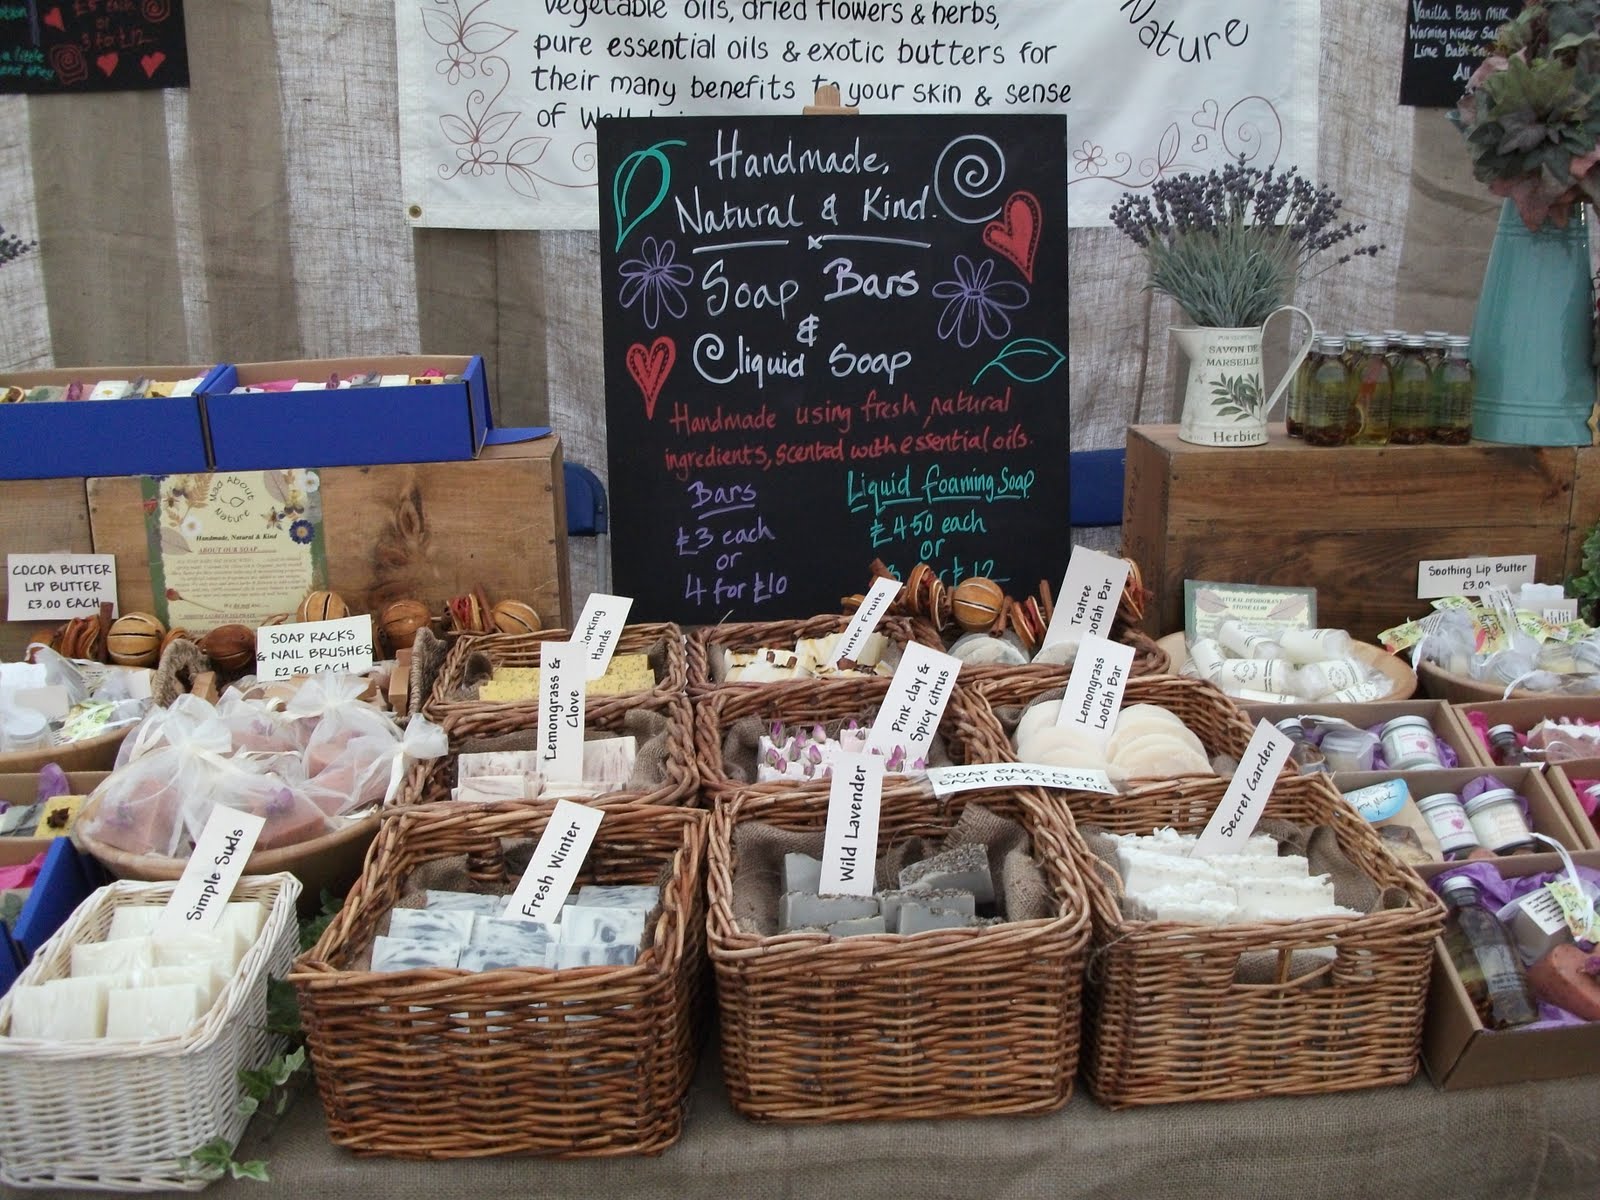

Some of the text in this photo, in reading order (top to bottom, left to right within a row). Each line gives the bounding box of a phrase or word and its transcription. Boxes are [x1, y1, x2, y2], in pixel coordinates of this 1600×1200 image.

[545, 0, 1000, 30] vegetable oils, dried flowers & herbs,
[1412, 0, 1512, 22] Vanilla Bath Milk
[533, 32, 1058, 65] pure essential oils & exotic butters for
[531, 65, 600, 91] their
[611, 76, 676, 106] many
[691, 74, 795, 100] benefits
[845, 83, 904, 107] your
[913, 84, 962, 104] skin
[975, 85, 992, 106] &
[1005, 82, 1072, 104] sense
[537, 102, 567, 128] of
[709, 128, 889, 180] Handmade,
[675, 184, 938, 235] Natural & Kind.
[702, 257, 919, 320] Soap Bars
[797, 313, 820, 347] &
[1208, 344, 1259, 354] SAVON DE
[829, 342, 912, 385] Soap
[1206, 357, 1260, 367] MARSEILLE
[669, 401, 777, 436] Handmade
[796, 400, 851, 433] using
[930, 386, 1012, 416] natural
[664, 423, 1034, 481] ingredients, scented with essential oils.
[209, 475, 255, 523] Mad About Nature
[688, 480, 757, 509] Bars
[847, 464, 911, 516] Liquid
[997, 466, 1035, 499] Soap
[676, 516, 776, 556] £3 each
[942, 508, 987, 535] each
[716, 552, 742, 571] or
[920, 538, 945, 560] or
[12, 564, 112, 576] COCOA BUTTER
[25, 581, 102, 592] LIP BUTTER
[685, 572, 787, 605] 4 for £10
[1428, 562, 1527, 578] Soothing Lip Butter
[28, 597, 100, 610] £3.00 EACH
[860, 592, 885, 623] Fruits
[1070, 584, 1092, 626] Teatree
[1088, 578, 1113, 635] oofah Bar
[256, 644, 373, 661] & NAIL BRUSHES
[270, 629, 355, 644] SOAP RACKS
[591, 629, 612, 660] Hands
[544, 657, 563, 761] Lemongrass &
[566, 690, 580, 728] Clove
[891, 663, 931, 733] Pink clay &
[910, 670, 949, 742] Spicy citrus
[1075, 657, 1105, 724] Lemongrass
[1094, 665, 1123, 730] Loofah Bar
[943, 769, 988, 779] SOAP
[1220, 740, 1276, 837] Secret Garden
[840, 765, 866, 881] Wild Lavender
[186, 829, 243, 920] Simple Suds
[522, 821, 581, 917] Fresh Winter
